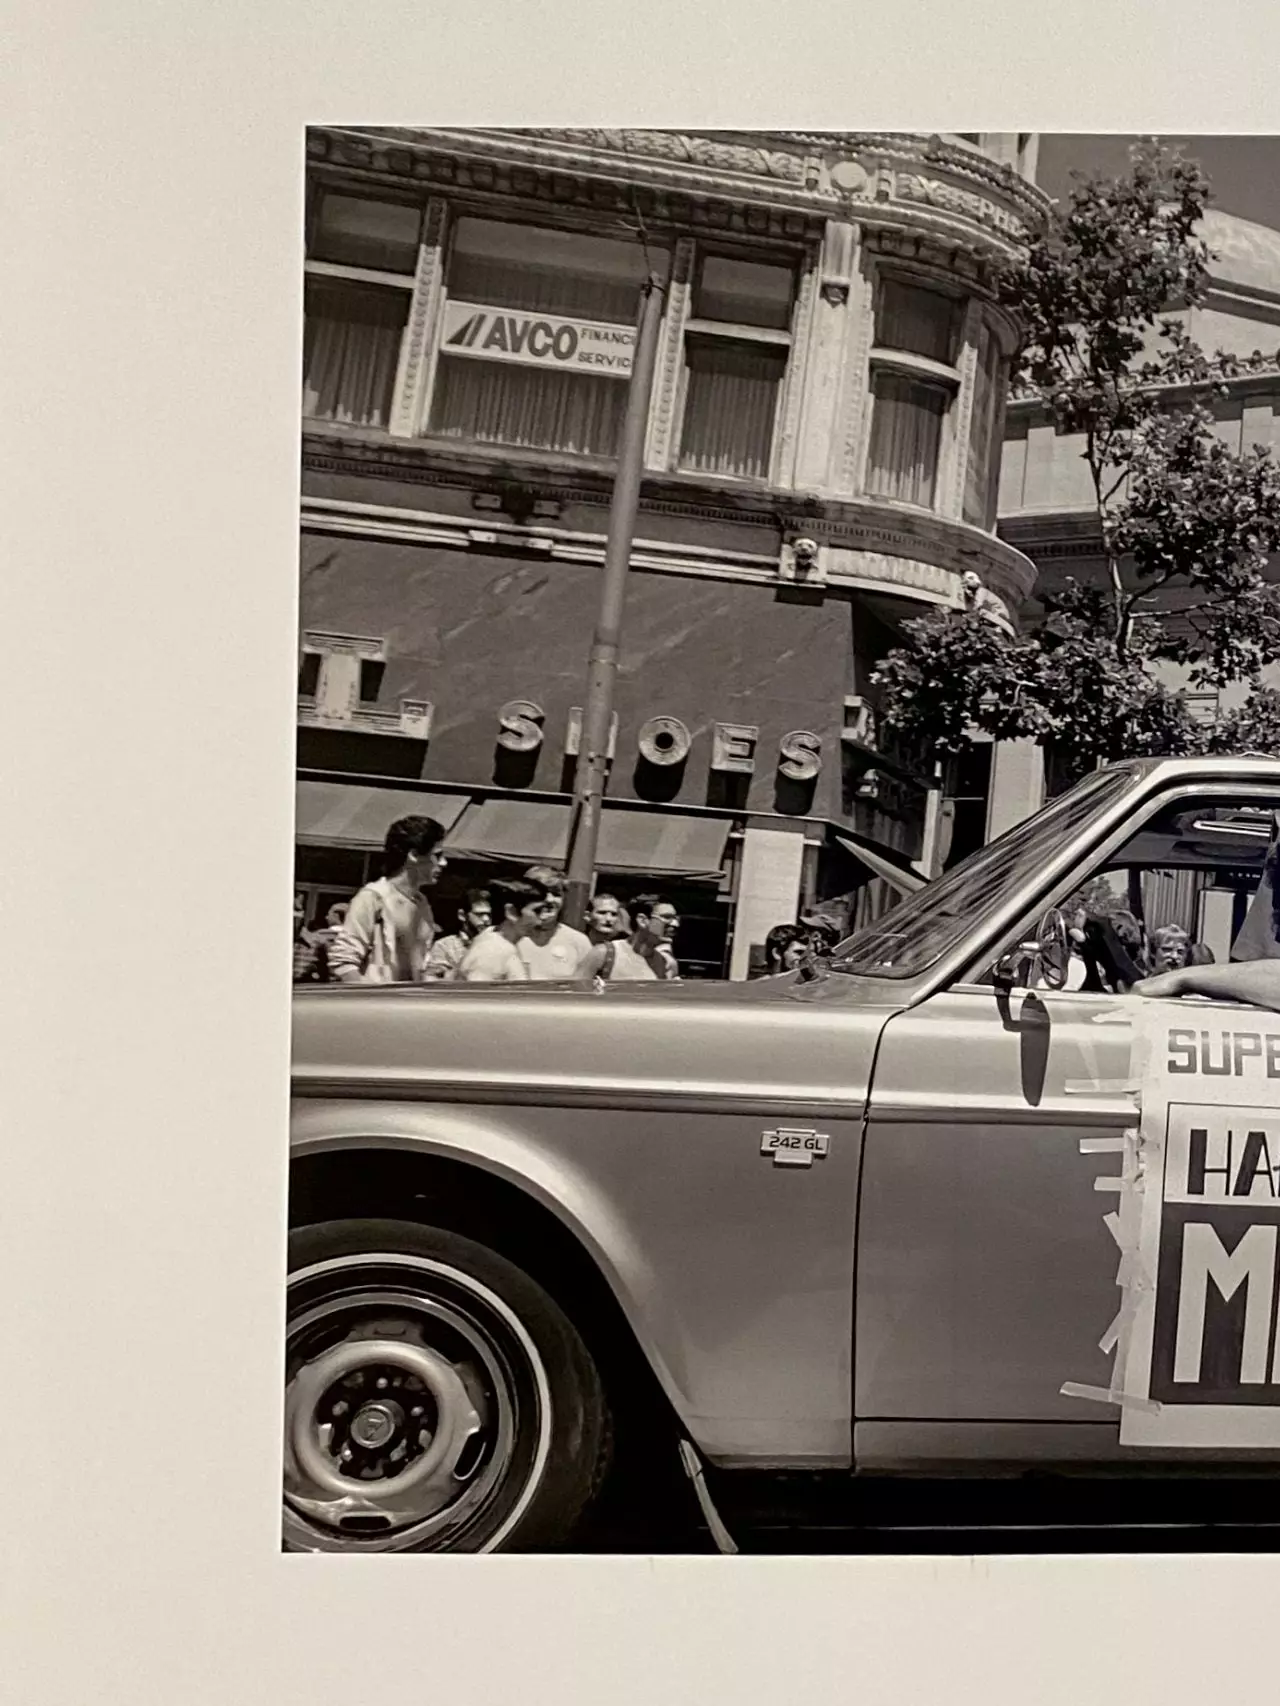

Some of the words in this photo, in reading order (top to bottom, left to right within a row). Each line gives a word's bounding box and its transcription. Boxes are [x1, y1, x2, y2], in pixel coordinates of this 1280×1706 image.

[481, 316, 579, 361] AVCO
[768, 1135, 801, 1149] 242
[804, 1138, 824, 1151] GL
